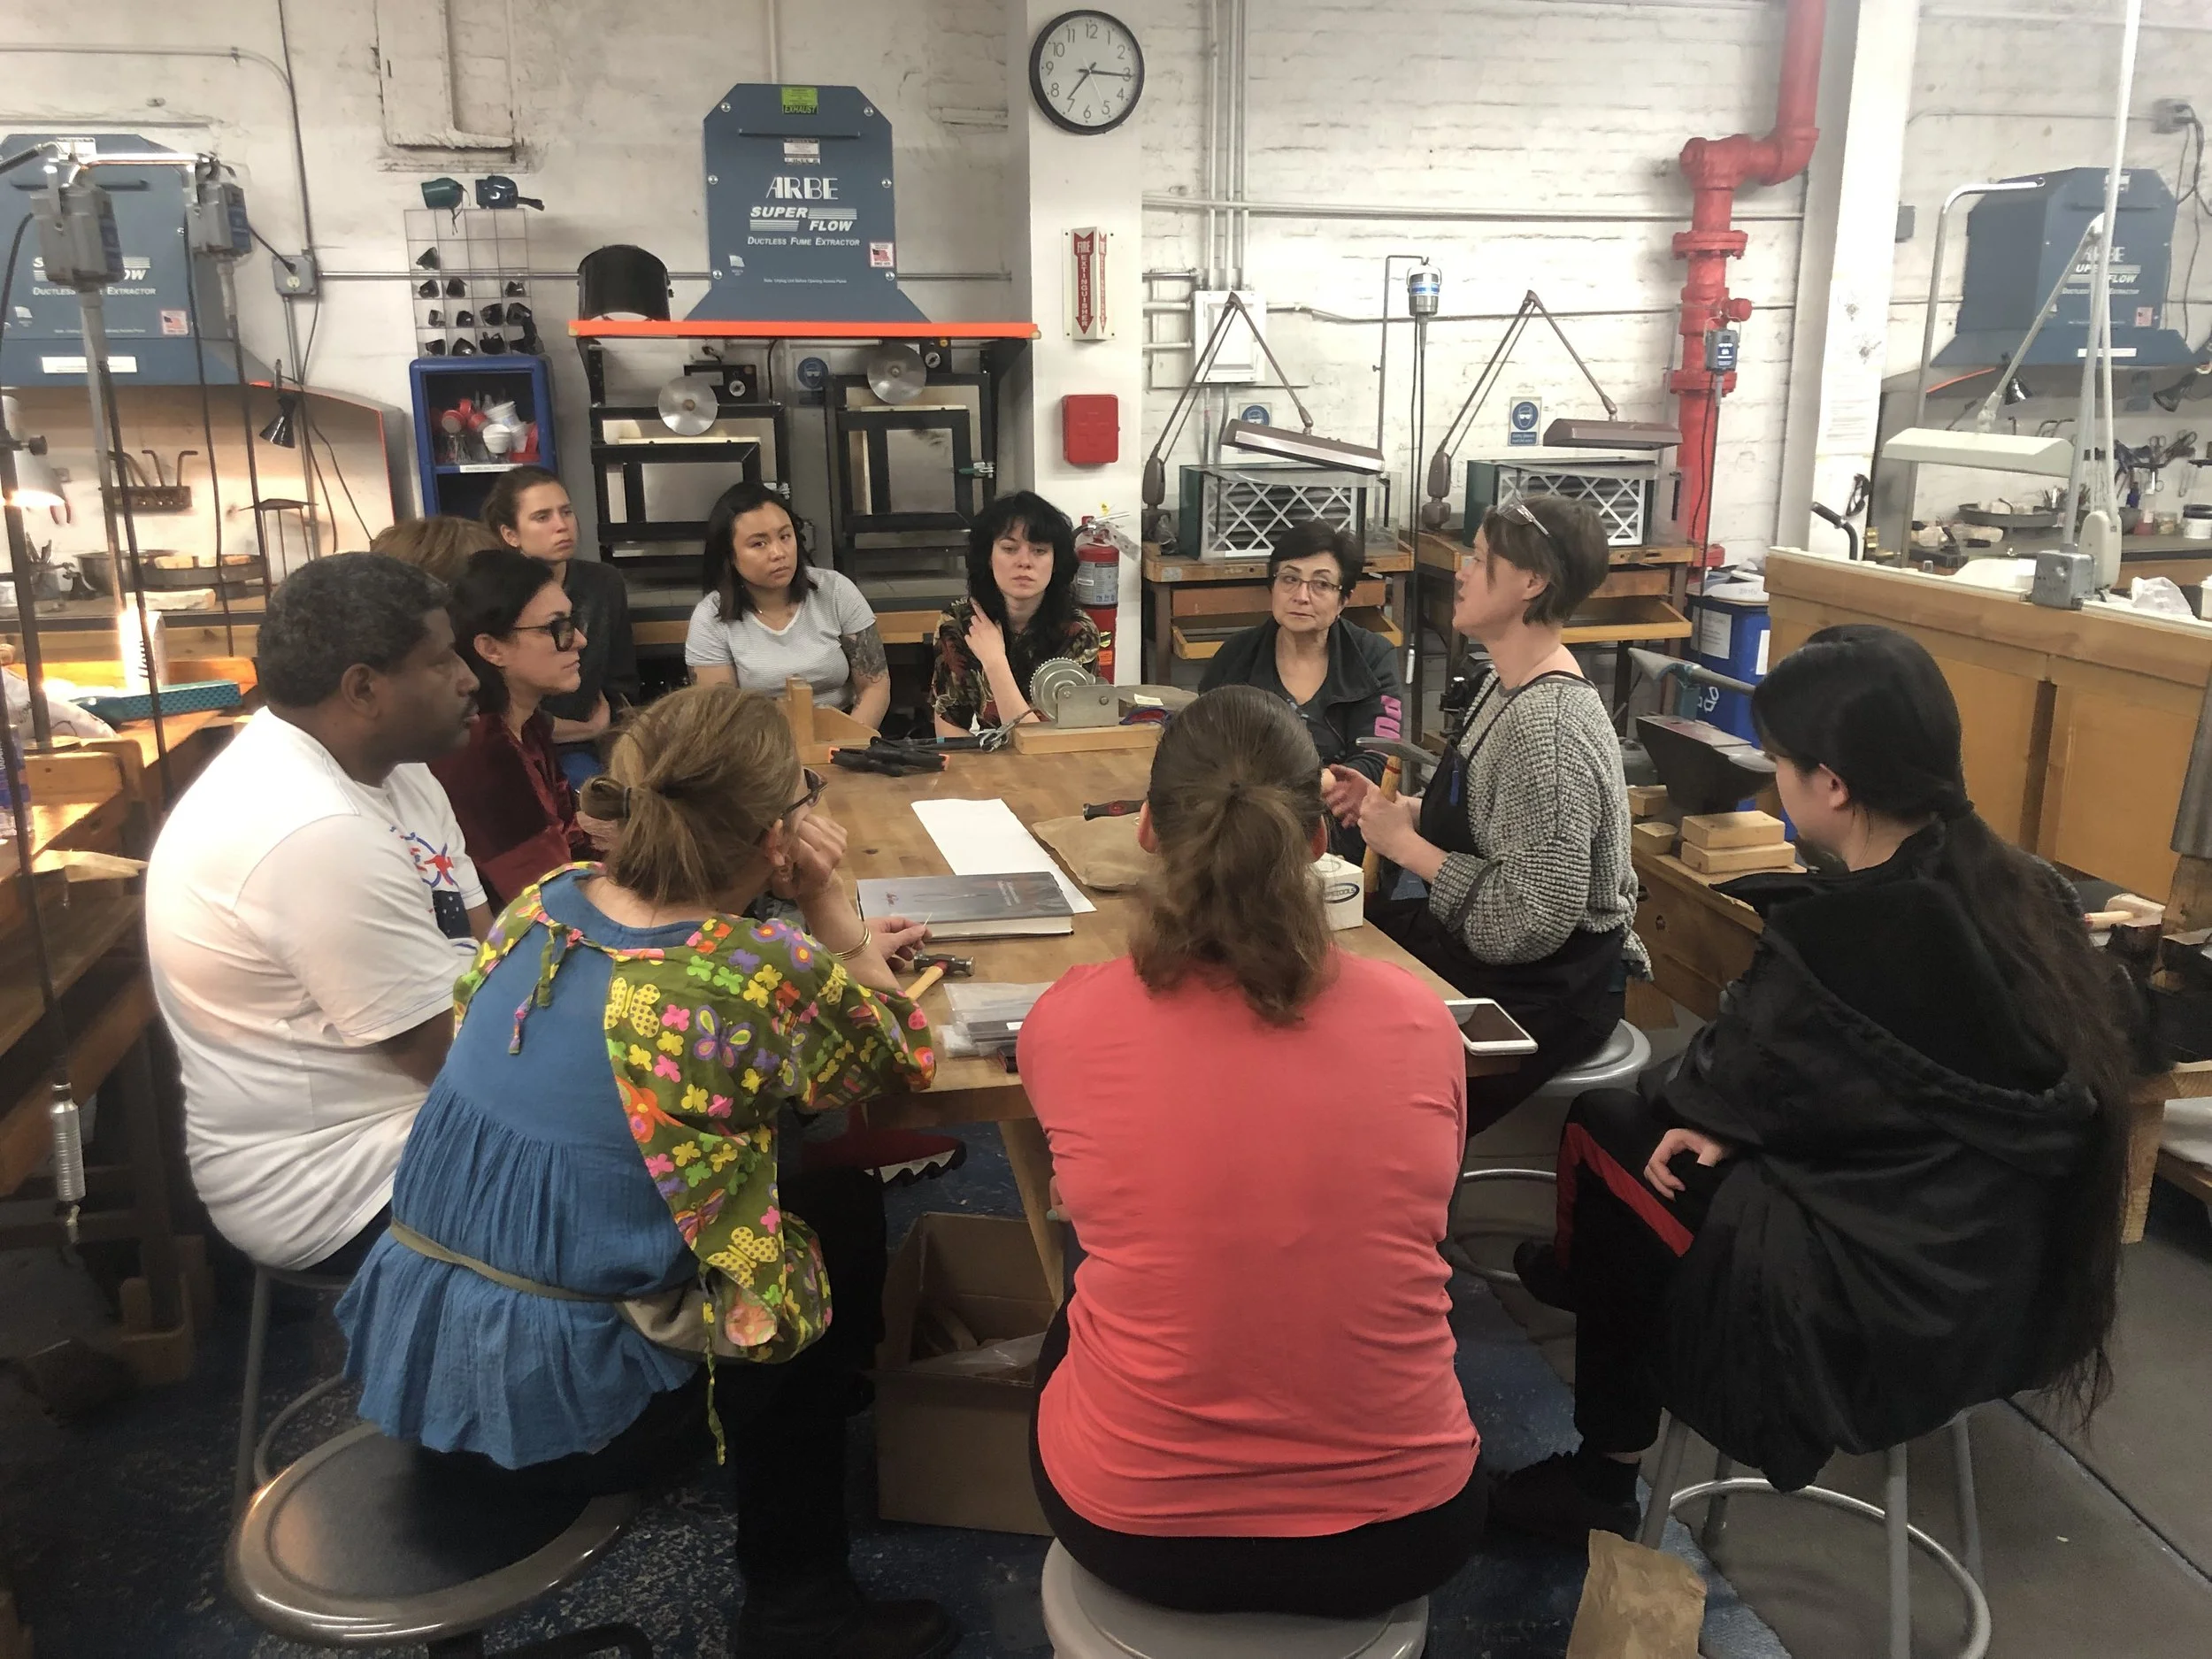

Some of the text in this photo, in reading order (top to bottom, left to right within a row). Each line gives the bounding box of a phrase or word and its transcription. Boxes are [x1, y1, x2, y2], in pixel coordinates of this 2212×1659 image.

[1067, 28, 1076, 43] 11
[1086, 23, 1098, 39] 12
[1052, 42, 1065, 58] 10
[1117, 44, 1125, 59] 2
[1046, 61, 1054, 76] 9
[1123, 66, 1132, 82] 3
[1050, 82, 1060, 97] 8
[1117, 87, 1125, 101] 4
[784, 105, 815, 114] EXHAUST
[1067, 98, 1075, 112] 7
[1083, 104, 1092, 119] 6
[1101, 100, 1110, 115] 5
[765, 176, 839, 200] ARBE
[750, 206, 809, 218] SUPER
[809, 220, 853, 232] FLOW
